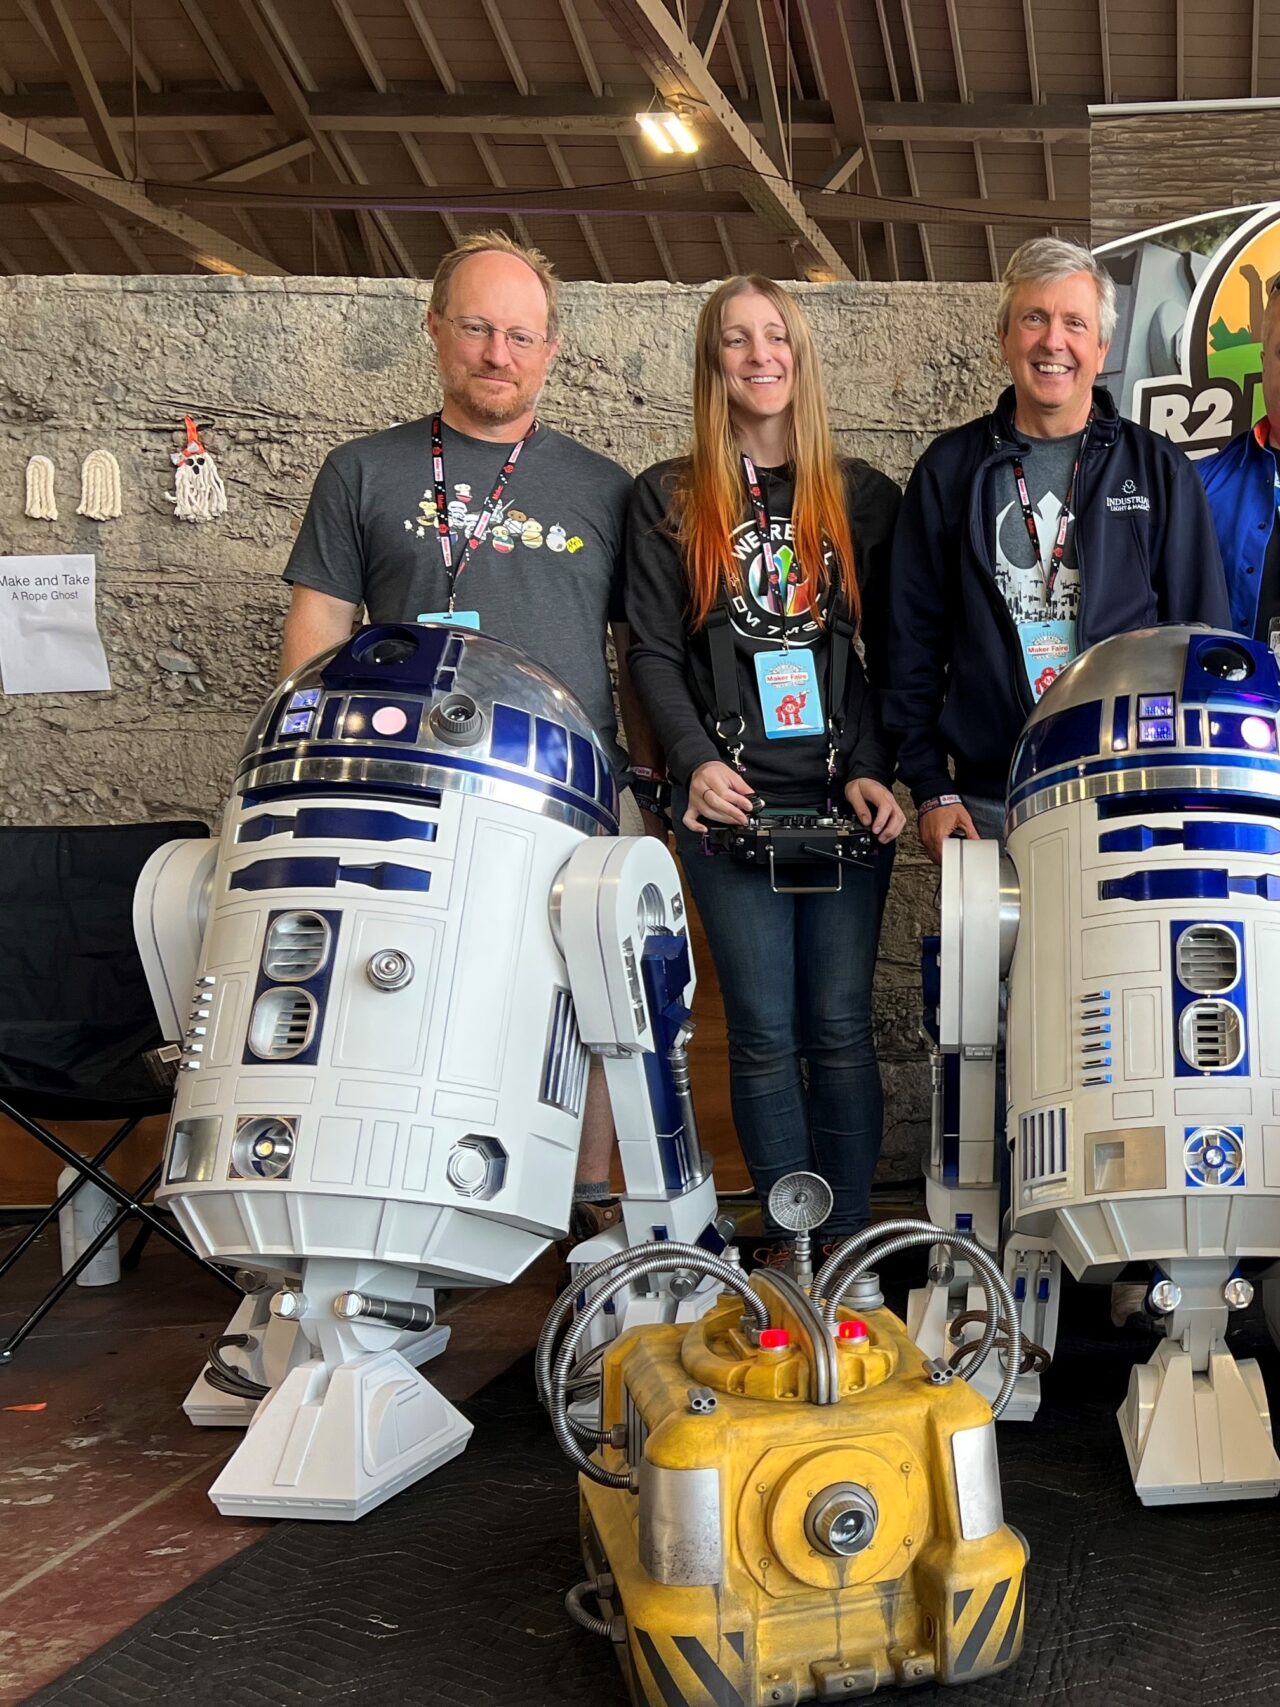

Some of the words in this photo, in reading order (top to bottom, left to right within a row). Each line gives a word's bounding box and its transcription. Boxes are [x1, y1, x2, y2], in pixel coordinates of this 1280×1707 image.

[1149, 388, 1233, 443] R2
[34, 575, 59, 586] and
[62, 574, 90, 586] Take
[11, 591, 19, 601] A
[21, 591, 48, 602] Rope
[51, 590, 79, 600] Ghost
[1051, 644, 1069, 652] Faire
[766, 674, 789, 682] Maker
[790, 672, 807, 680] Faire
